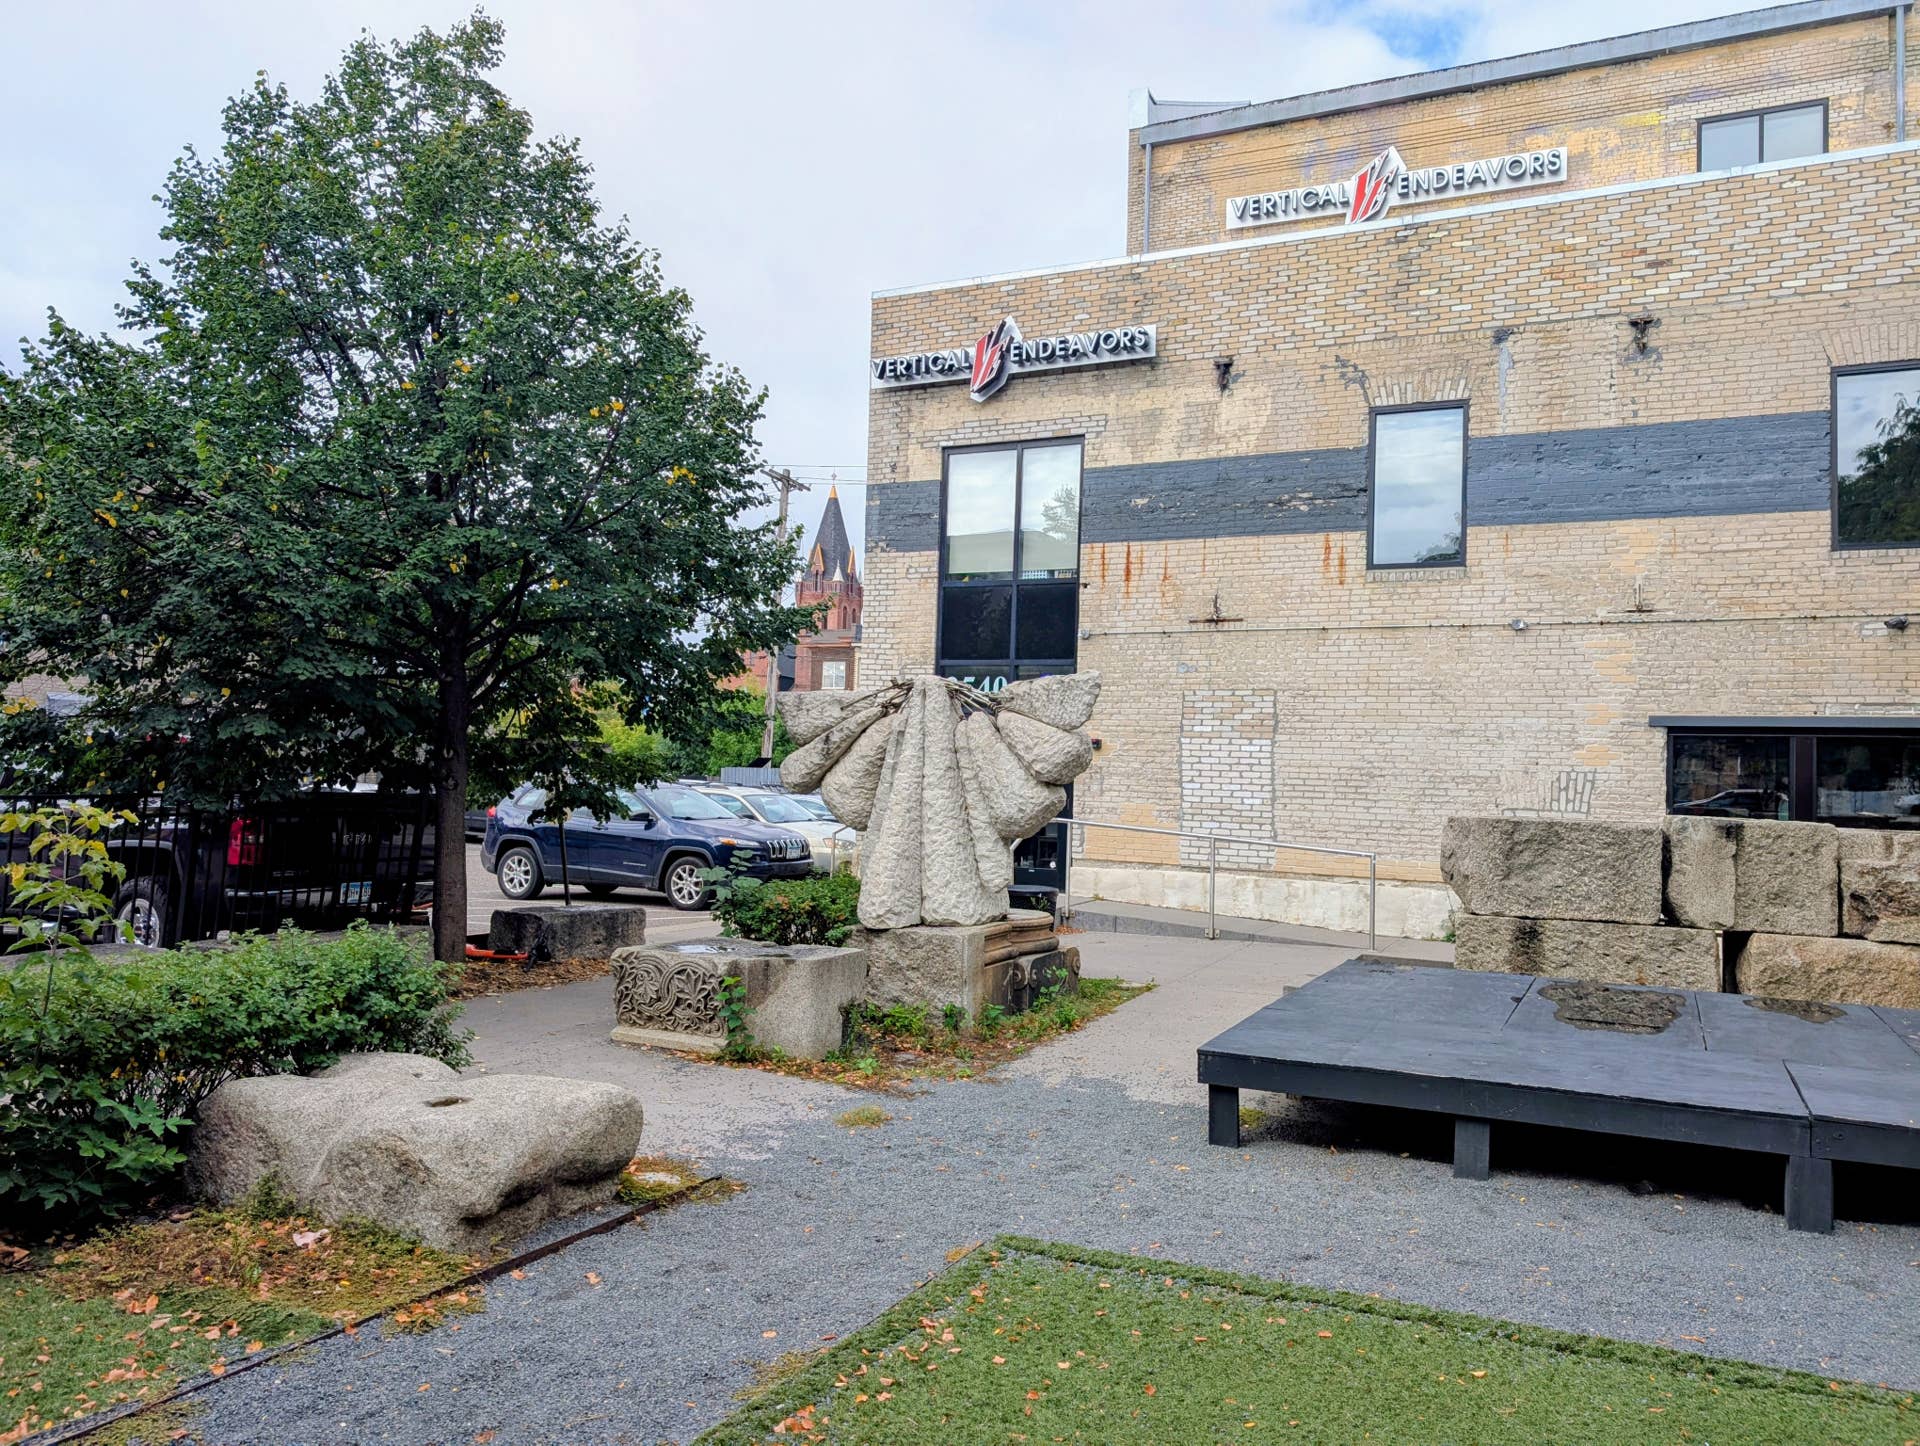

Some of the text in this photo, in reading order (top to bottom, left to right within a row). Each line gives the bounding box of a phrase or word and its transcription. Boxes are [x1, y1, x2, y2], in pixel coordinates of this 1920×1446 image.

[1231, 186, 1349, 218] VERTICAL
[1398, 150, 1562, 195] ENDEAVORS
[873, 350, 970, 378] VERTICAL
[1010, 327, 1146, 361] ENDEAVORS
